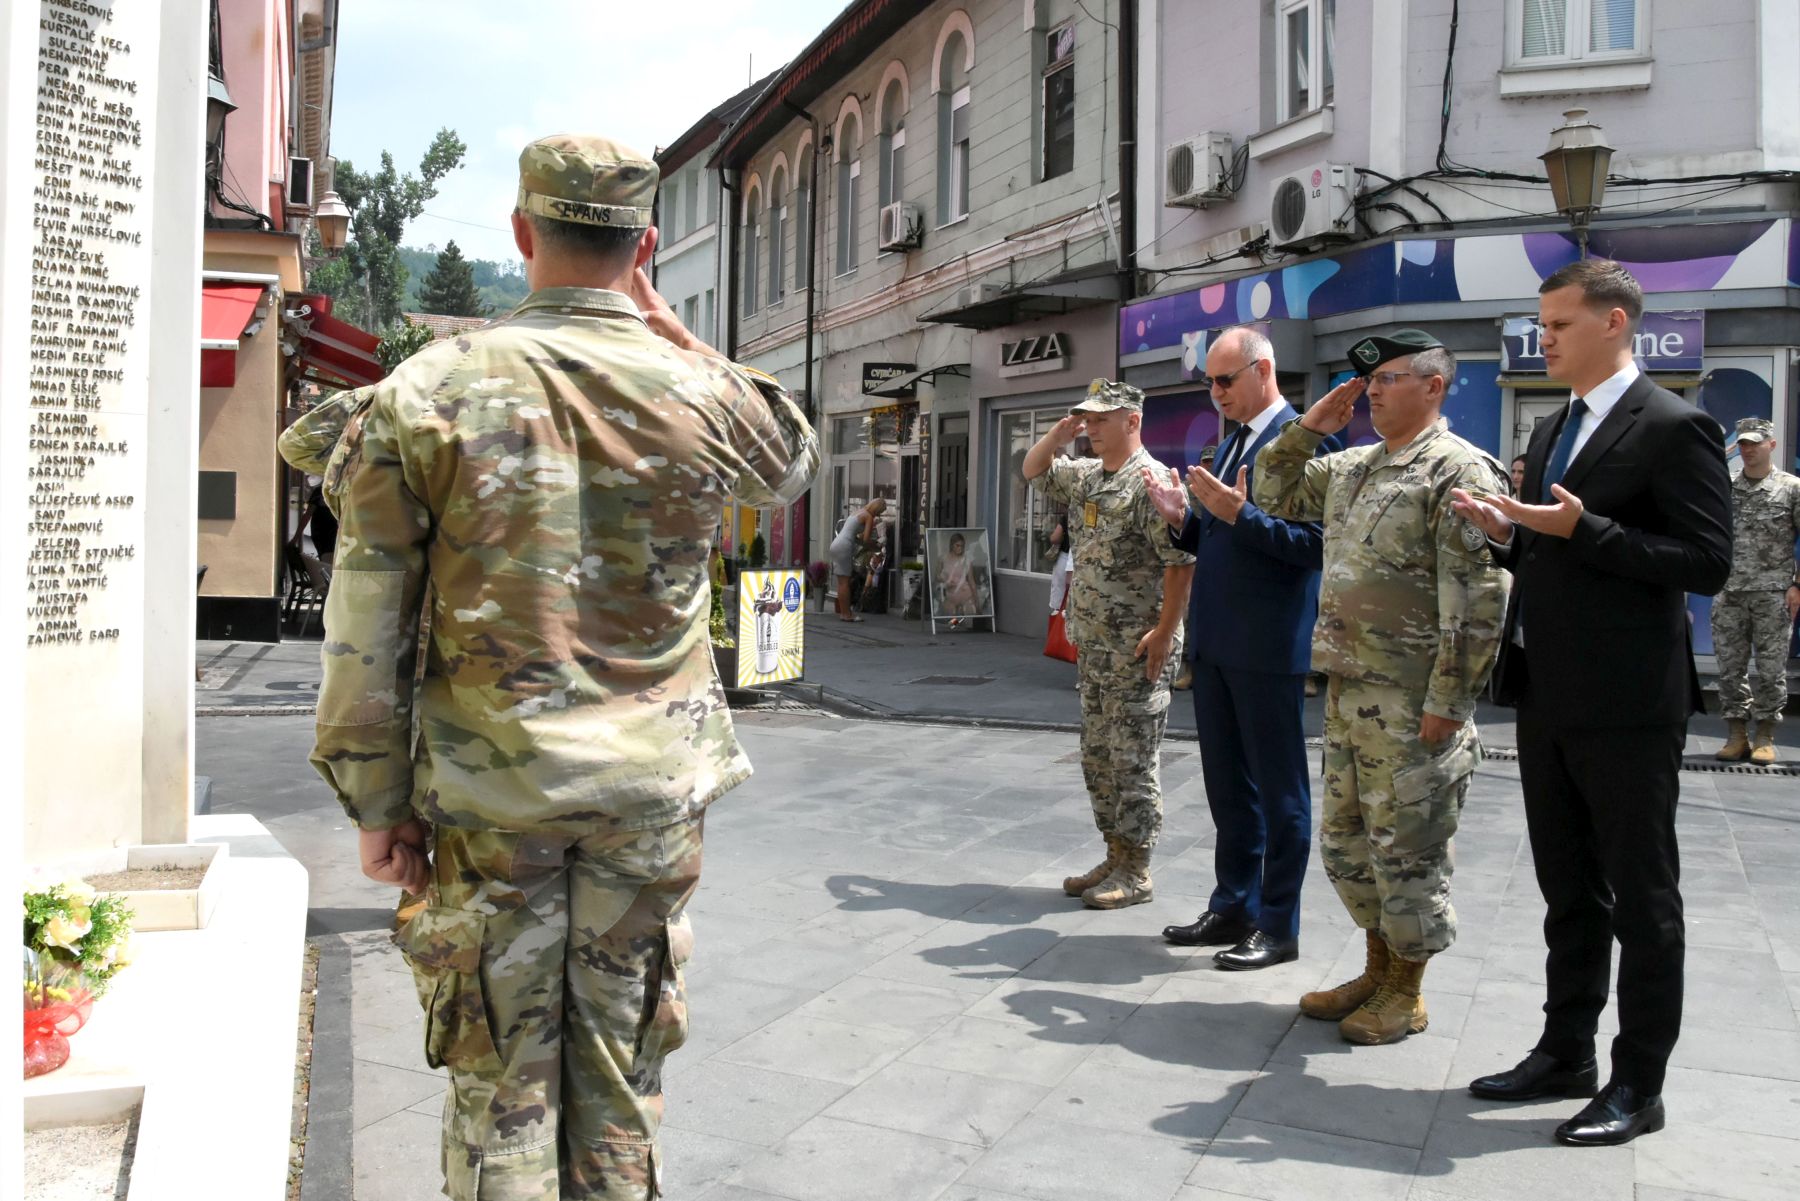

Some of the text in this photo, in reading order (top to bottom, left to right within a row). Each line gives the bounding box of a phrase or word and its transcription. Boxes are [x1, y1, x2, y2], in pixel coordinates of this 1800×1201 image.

[41, 0, 113, 21] URBEGOVIĆ
[50, 9, 88, 29] VESNA
[40, 19, 130, 53] KURTALIĆ VECA
[49, 37, 108, 60] SULEJMAN
[39, 48, 105, 72] MEHANOVIĆ
[38, 61, 137, 93] PERA MARINOVIĆ
[46, 76, 85, 95] NENAD
[38, 86, 132, 116] MARKOVIĆ NEŠO
[38, 102, 74, 117] AMIRA
[37, 115, 141, 146] EDIN MEHMEDOVIĆ
[36, 130, 113, 155] EDISA MEMIĆ
[37, 143, 132, 172] ADRIJANA MILIĆ
[35, 158, 142, 189] NEŠET MUJANOVIĆ
[44, 176, 71, 188] EDIN
[1312, 189, 1321, 198] LG
[34, 203, 112, 224] SAMIR MUJIĆ
[563, 201, 611, 223] EVANS
[34, 217, 141, 244] ELVIR MURSELOVIĆ
[42, 229, 82, 248] ŠABAN
[33, 246, 104, 264] MUSTAČEVIĆ
[33, 259, 74, 274] DIJANA
[32, 275, 140, 297] SELMA NUHANOVIĆ
[32, 290, 133, 312] INDIRA OKANOVIĆ
[32, 305, 134, 326] RUSMIR PONJAVIĆ
[32, 320, 118, 338] RAIF RAHMANI
[31, 335, 127, 352] FAHRUDIN RAMIĆ
[31, 350, 105, 364] NEDIM REKIĆ
[30, 365, 123, 381] JASMINKO ROSIĆ
[30, 380, 98, 395] NIHAD ŠIŠIĆ
[31, 395, 101, 409] ARMIN ŠIŠIĆ
[38, 413, 87, 424] SENAHID
[30, 424, 98, 437] SALAMOVIĆ
[30, 440, 69, 449] EDHEM
[38, 455, 95, 466] JASMINKA
[36, 482, 64, 492] ASIM
[29, 492, 134, 506] SLIJEPČEVIĆ ASKO
[35, 510, 65, 520] SAVO
[28, 519, 103, 532] STJEPANOVIĆ
[35, 538, 80, 548] JELENA
[27, 560, 103, 576] ILINKA TADIĆ
[28, 576, 107, 591] AZUR VANTIĆ
[37, 593, 88, 604] MUSTAFA
[27, 603, 77, 616] VUKOVIĆ
[37, 620, 77, 631] ADNAN
[28, 629, 83, 646] ZAIMOVIĆ
